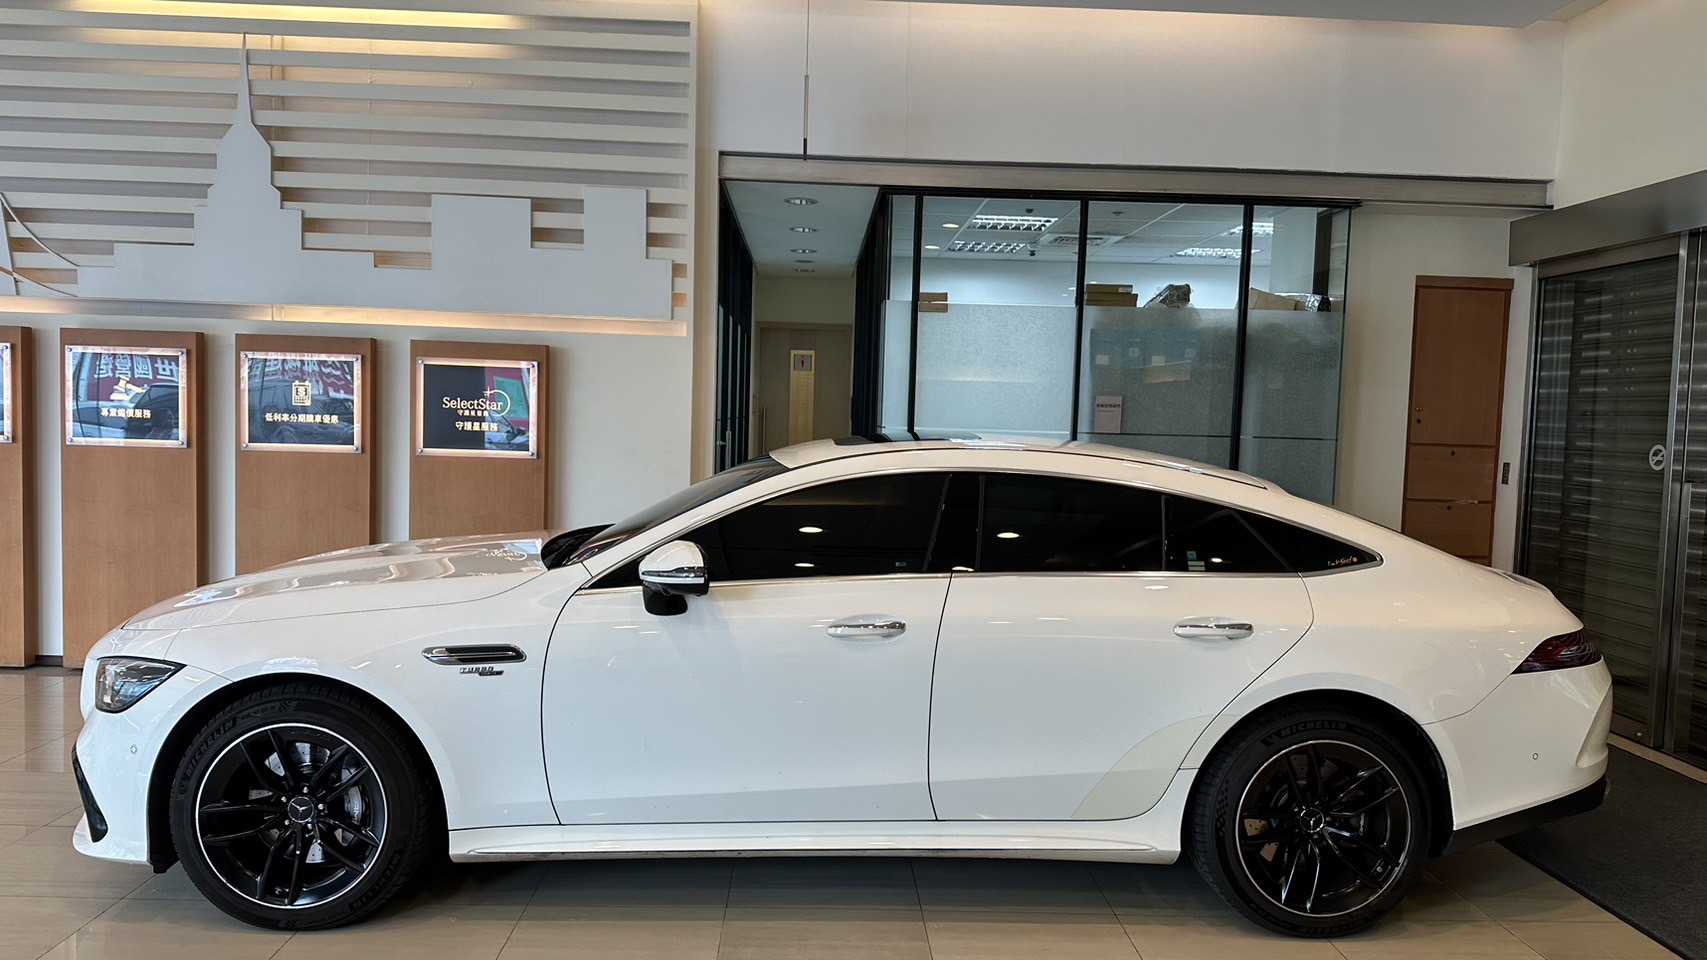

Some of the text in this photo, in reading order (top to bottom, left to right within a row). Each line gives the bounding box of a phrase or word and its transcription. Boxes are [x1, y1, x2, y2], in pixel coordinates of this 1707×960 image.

[442, 396, 504, 410] SelectStar
[455, 421, 498, 432] 守護星服務
[1281, 720, 1346, 737] MICHELIN
[186, 719, 234, 777] MICHELIN
